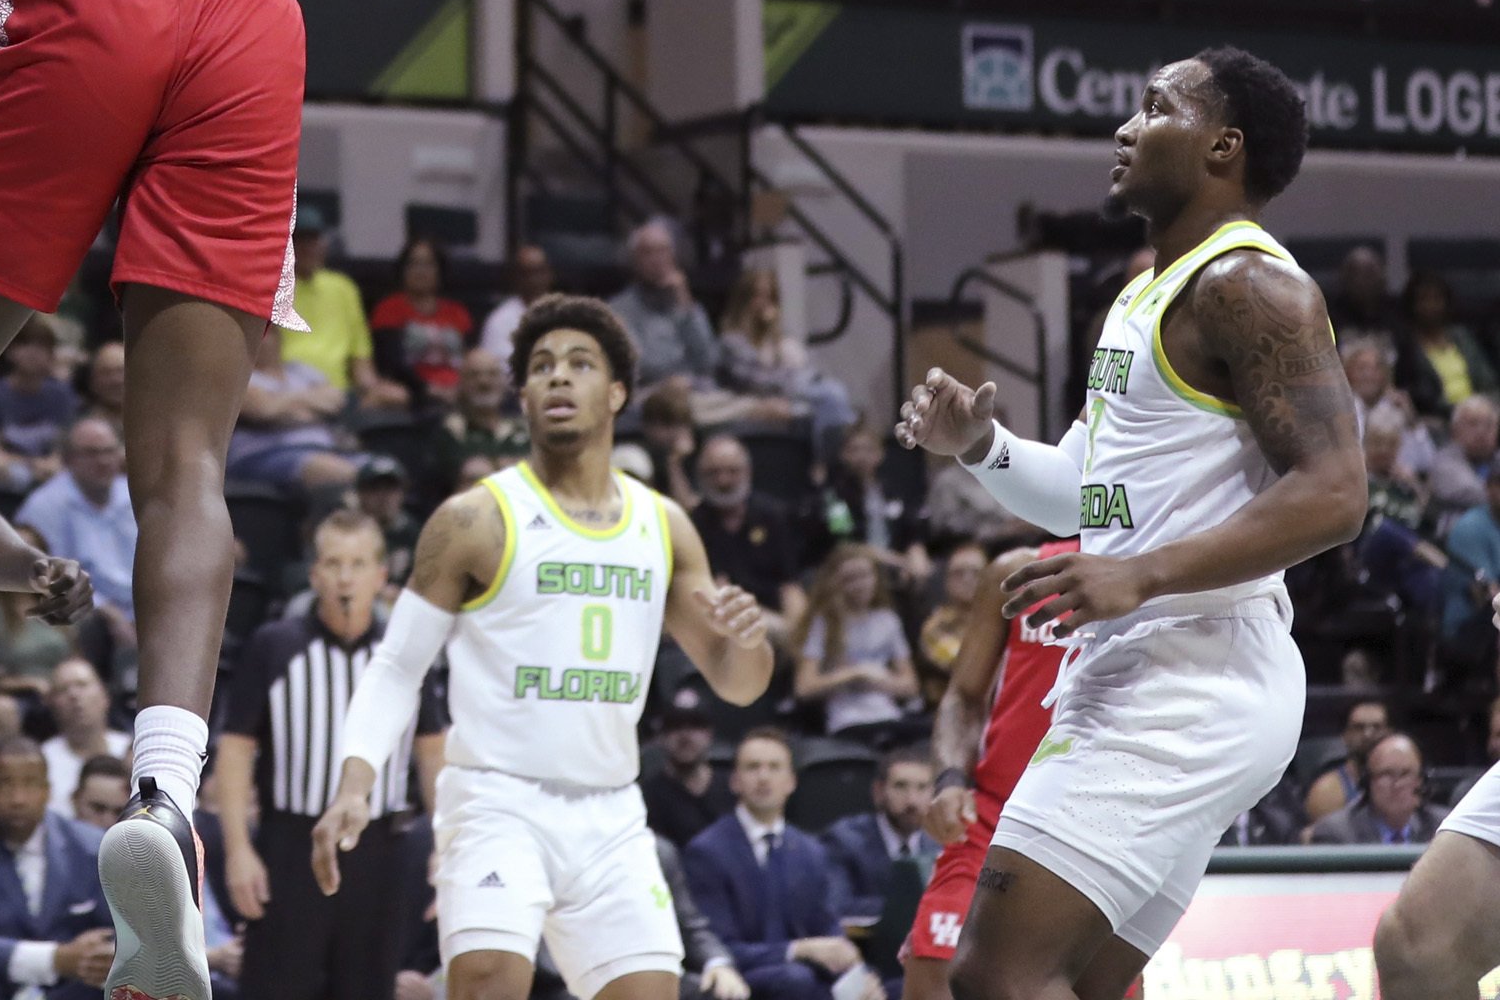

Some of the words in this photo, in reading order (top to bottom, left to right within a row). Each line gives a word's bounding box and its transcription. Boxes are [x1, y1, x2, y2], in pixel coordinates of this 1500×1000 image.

[1086, 347, 1135, 395] OUTH
[1080, 484, 1135, 530] RIDA
[536, 562, 652, 602] SOUTH
[581, 603, 613, 662] 0
